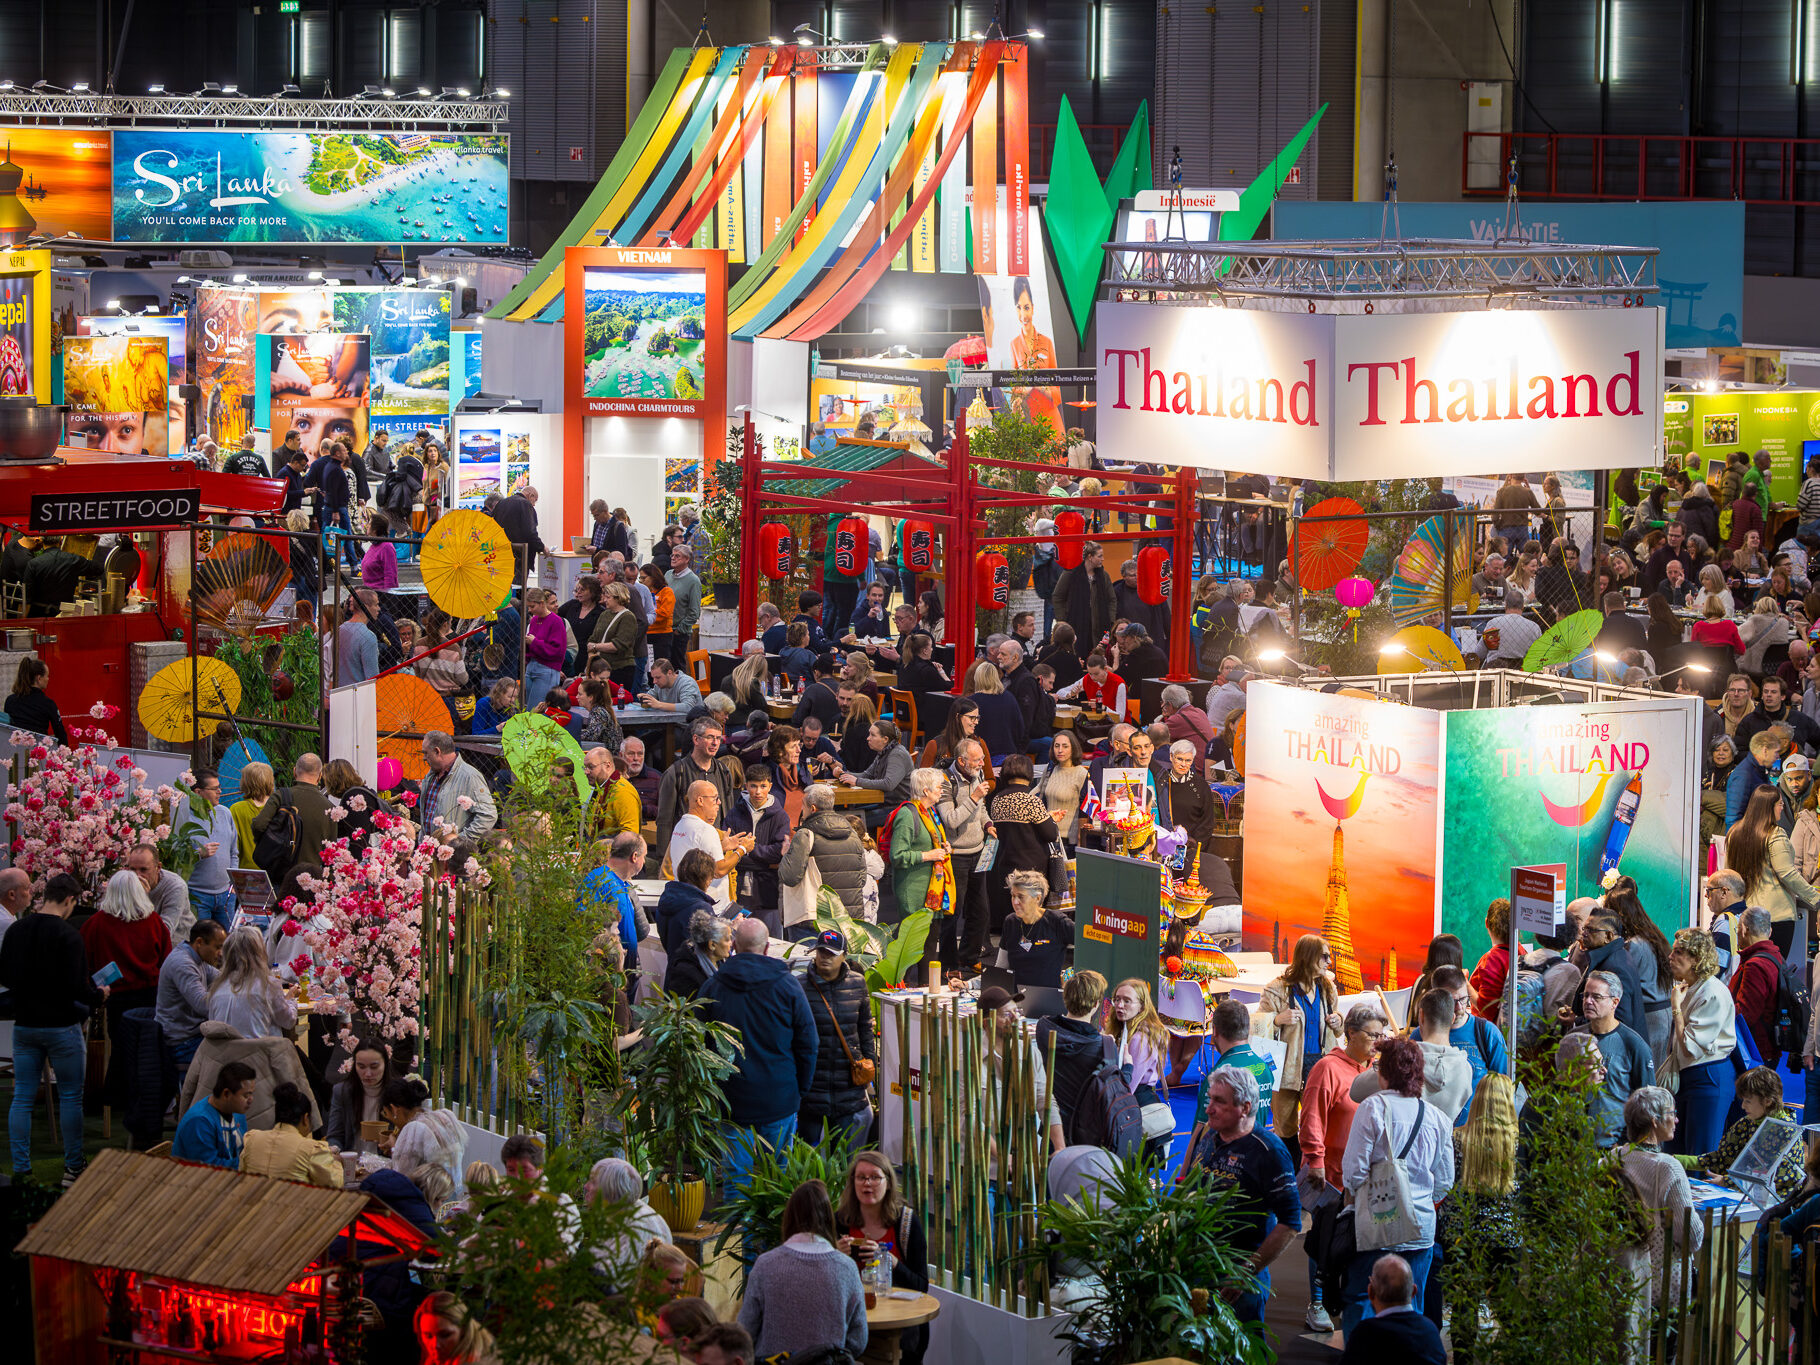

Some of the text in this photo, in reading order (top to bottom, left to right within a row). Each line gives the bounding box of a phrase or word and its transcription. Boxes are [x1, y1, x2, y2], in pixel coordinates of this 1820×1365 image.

[133, 149, 293, 212] Sri Lanka
[142, 216, 287, 226] YOU'LL COME BACK FOR MORE
[9, 256, 26, 267] NEPAL
[617, 250, 672, 264] VIETNAM
[0, 294, 27, 331] epal
[380, 298, 441, 322] Sri Lanka
[204, 318, 249, 355] Sri Lanka
[1104, 347, 1320, 427] Thailand
[1347, 350, 1644, 427] Thailand
[371, 399, 411, 408] TREAMS.
[589, 402, 696, 413] INDOCHINA CHARMTOURS
[1753, 406, 1798, 414] INDONESIA
[371, 422, 433, 431] THE STREET
[39, 497, 191, 522] STREETFOOD
[836, 530, 855, 570] 寿司
[910, 530, 930, 566] 寿司
[1314, 713, 1369, 740] amazing
[1538, 719, 1610, 742] amazing
[1283, 729, 1402, 776] THAILAND
[1495, 742, 1650, 778] THAILAND
[1094, 908, 1146, 937] koningaap
